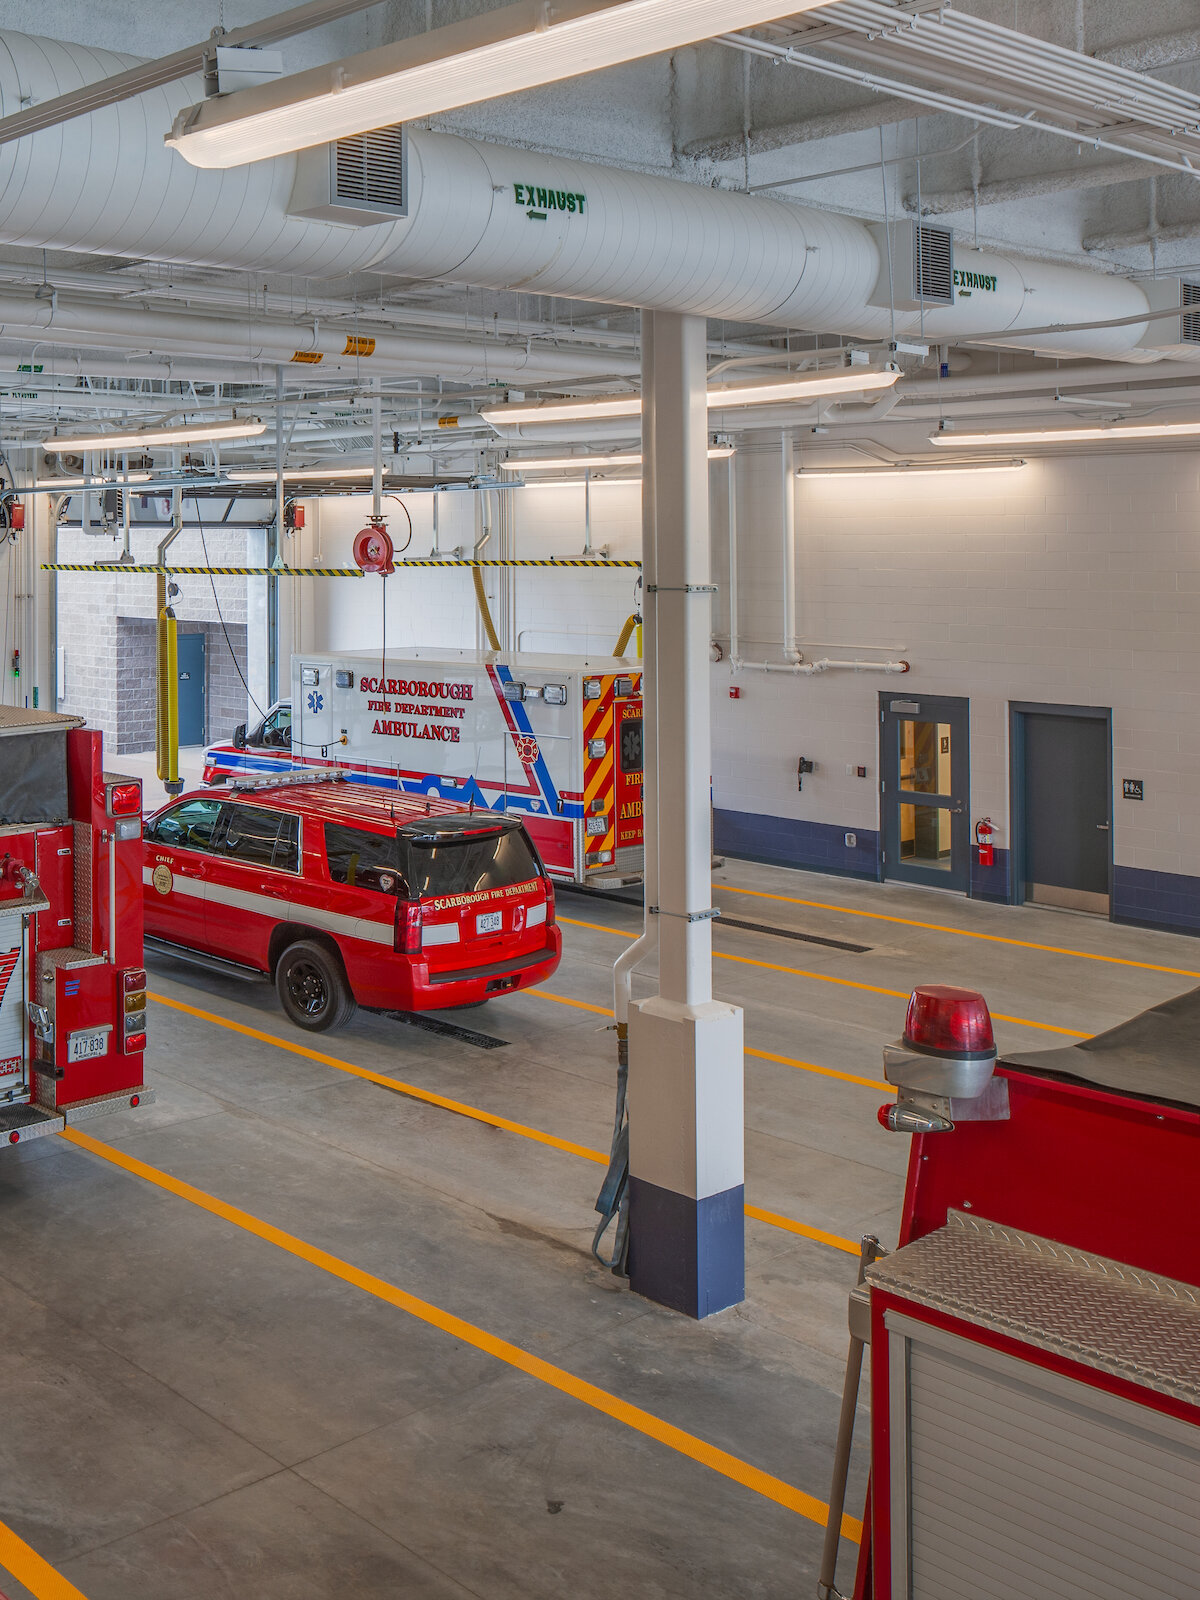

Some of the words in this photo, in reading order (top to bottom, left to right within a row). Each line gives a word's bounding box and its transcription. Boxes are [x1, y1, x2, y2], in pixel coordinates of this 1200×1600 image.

[513, 183, 586, 214] EXHAUST
[953, 269, 997, 292] EXHAUST
[360, 676, 474, 700] SCARBOROUGH
[367, 700, 391, 713] FIRE
[394, 702, 466, 719] DEPARTMENT
[371, 719, 460, 743] AMBULANCE
[620, 830, 636, 840] KEEP
[155, 854, 174, 865] CHIEF
[434, 892, 489, 911] SCARBOROUGH
[491, 889, 504, 899] FIRE
[505, 881, 538, 896] DEPARTMENT
